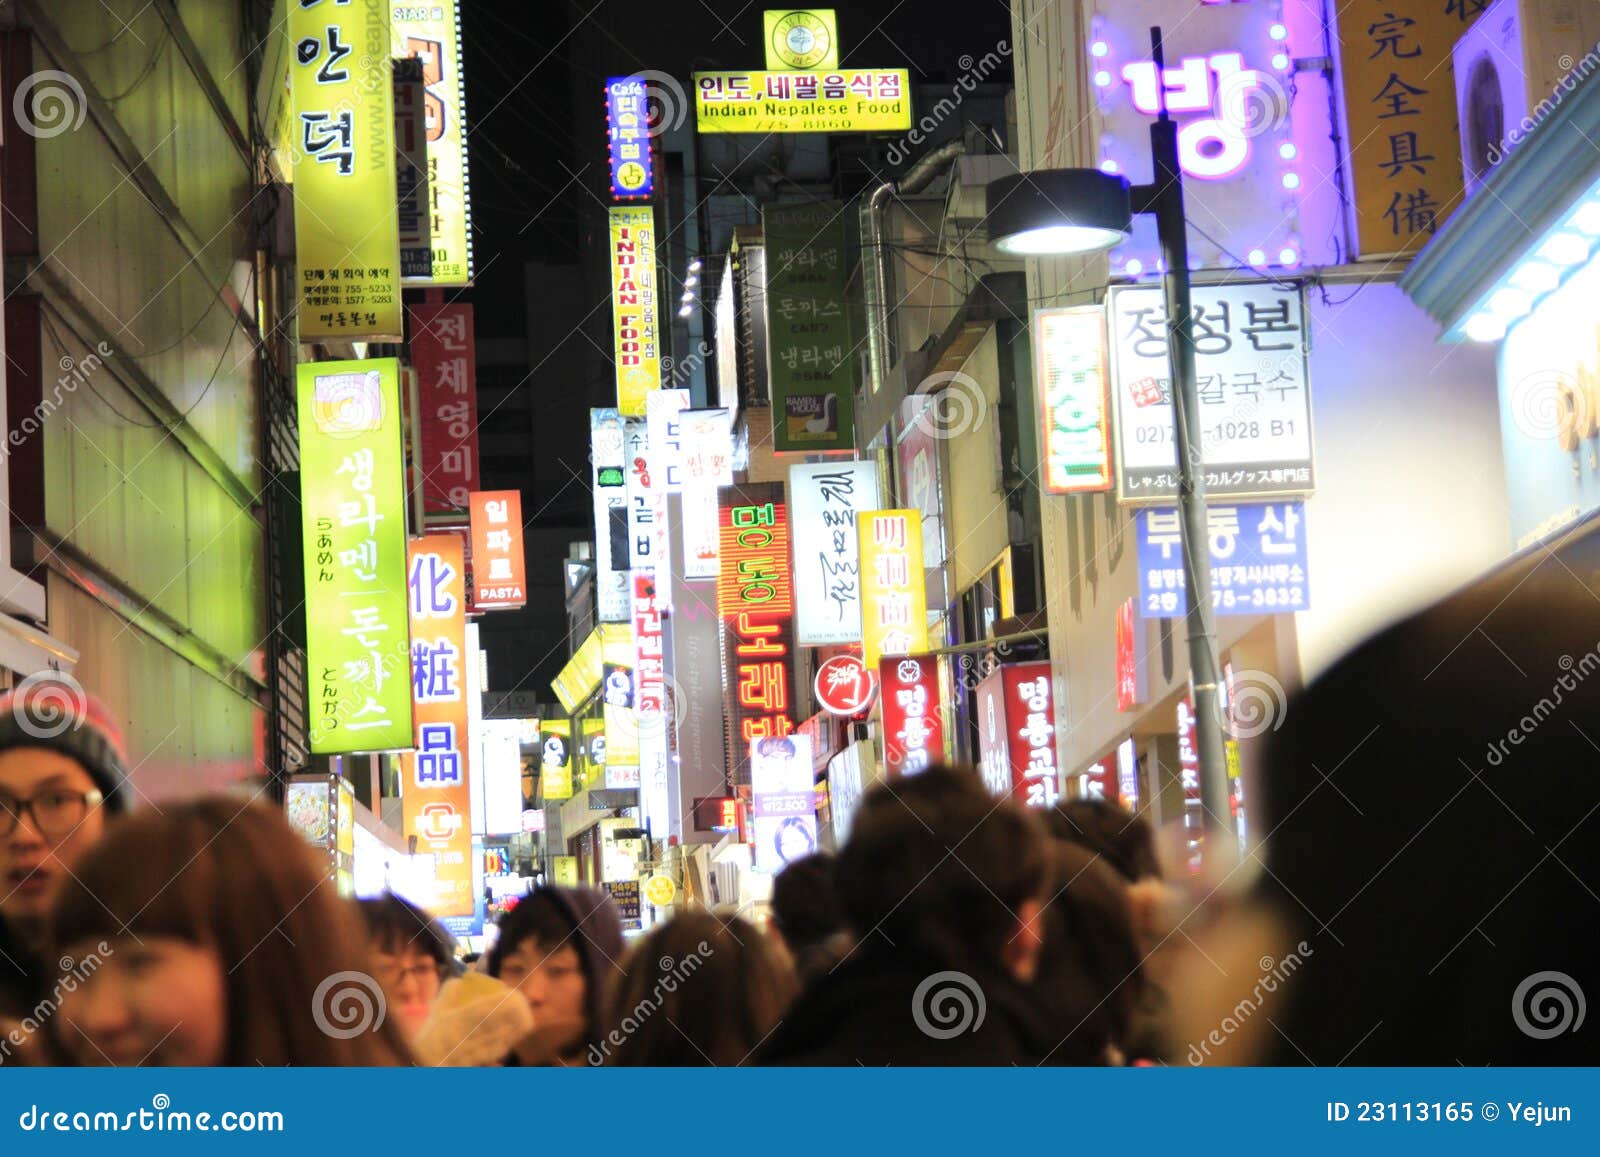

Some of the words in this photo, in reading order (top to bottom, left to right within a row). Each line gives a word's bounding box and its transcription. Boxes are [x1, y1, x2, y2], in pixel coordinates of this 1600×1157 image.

[699, 74, 900, 100] 인도,네팔음식점
[704, 104, 757, 116] Indian
[766, 103, 848, 117] Nepalese
[857, 101, 901, 114] Food
[1366, 13, 1440, 236] 完全具備
[616, 228, 637, 305] INDIAN
[620, 315, 640, 366] FOOD
[1196, 369, 1299, 404] 칼국수
[1135, 421, 1260, 444] 02)7-1028
[1270, 419, 1295, 437] B1
[335, 447, 384, 582] 생라멘
[1146, 504, 1300, 560] 부동산
[480, 586, 522, 600] PASTA
[341, 605, 393, 732] 돈까스
[409, 556, 459, 784] 化粧品
